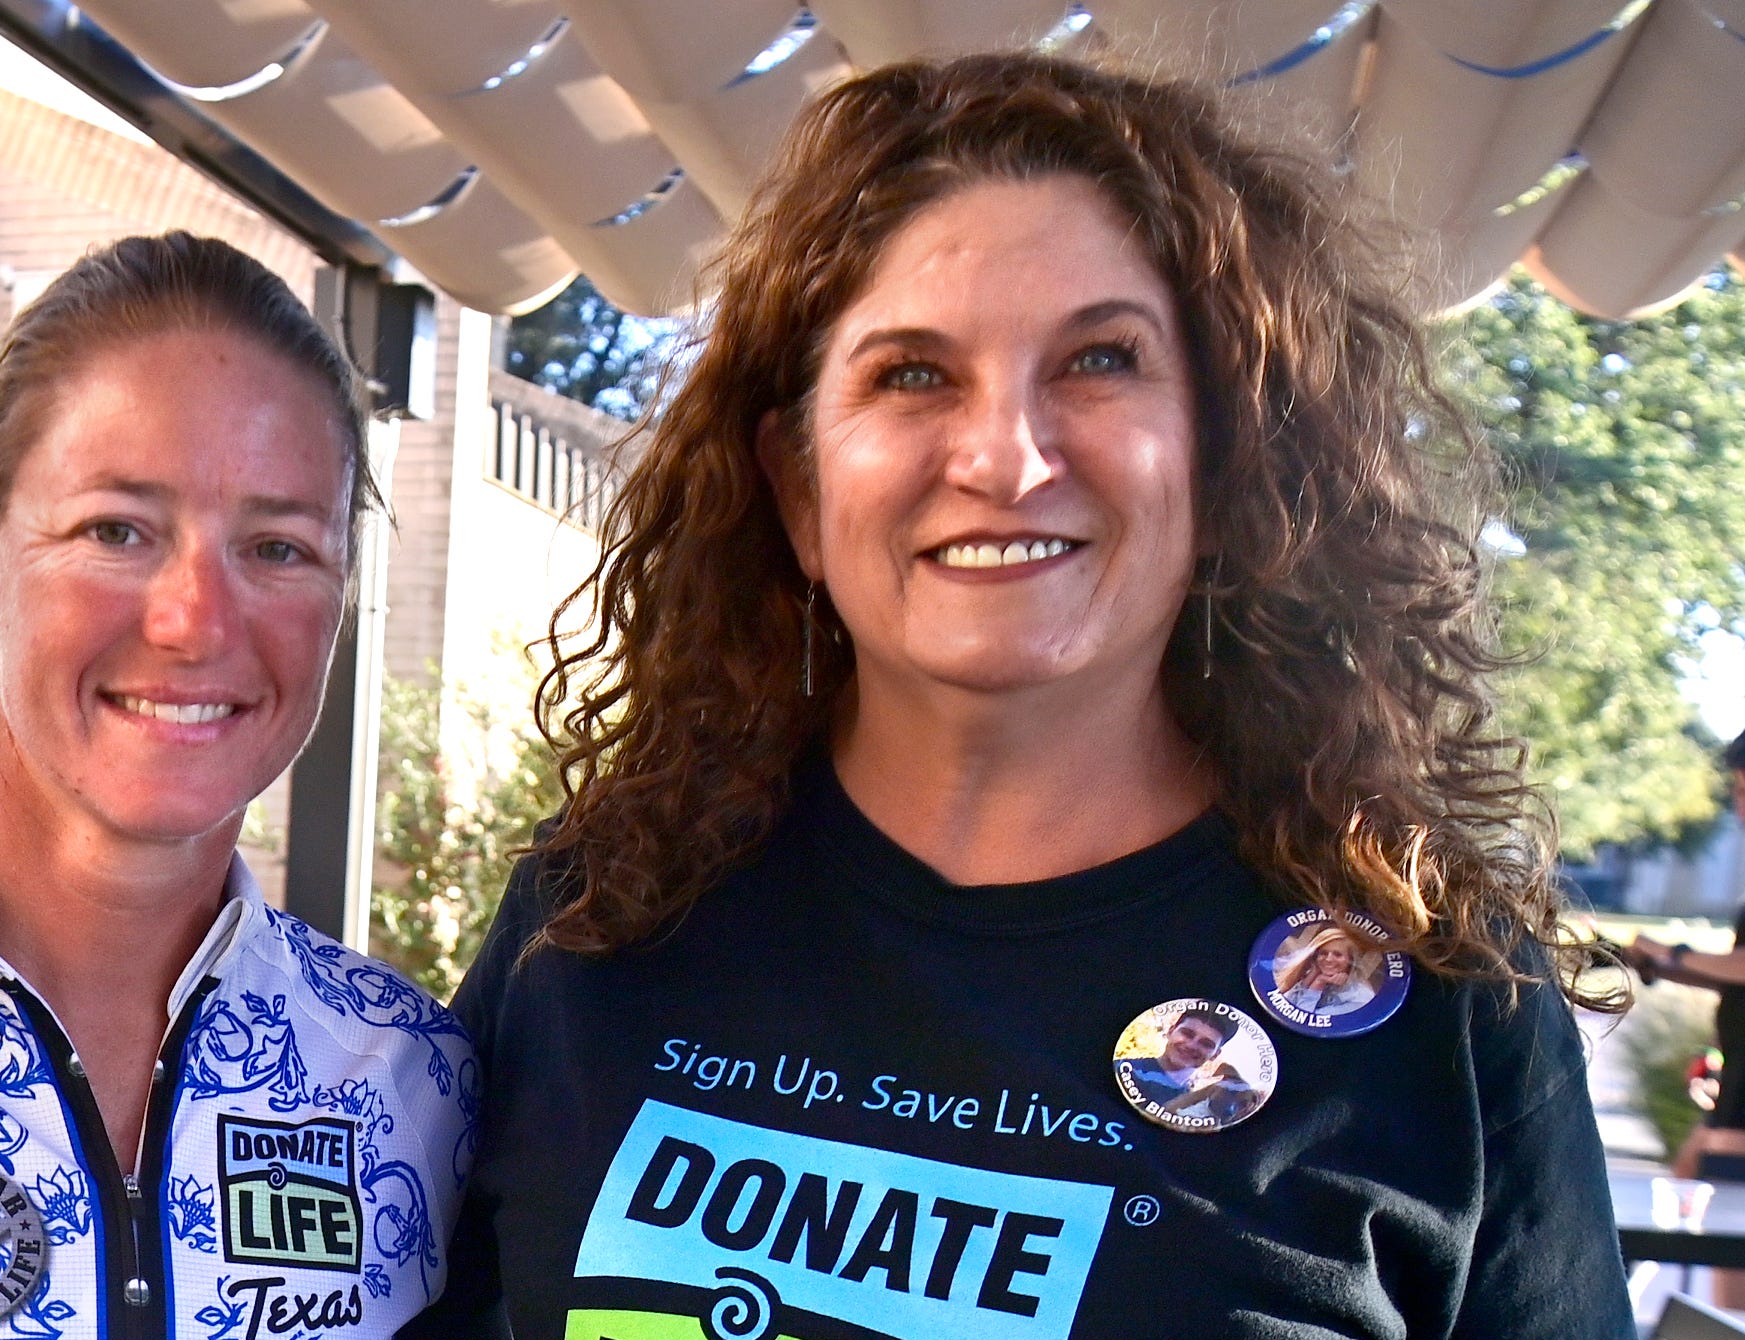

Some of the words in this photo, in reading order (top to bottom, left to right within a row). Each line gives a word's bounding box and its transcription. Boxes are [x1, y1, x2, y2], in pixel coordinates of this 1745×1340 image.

[1286, 909, 1334, 928] ORGA
[1386, 951, 1404, 978] ERO
[1153, 1000, 1209, 1016] Organ
[1215, 1002, 1265, 1041] Donor
[1257, 1043, 1275, 1082] Hero
[1267, 989, 1308, 1026] MORGAN
[1307, 1013, 1333, 1028] LEE
[653, 1038, 757, 1091] Sign
[772, 1056, 845, 1107] Up.
[862, 1074, 977, 1130] Save
[995, 1091, 1134, 1151] Lives.
[1119, 1061, 1147, 1104] Casey
[1145, 1101, 1216, 1128] Blanton
[232, 1130, 344, 1168] DONATE
[238, 1190, 353, 1255] LIFE
[624, 1135, 1065, 1318] DONATE
